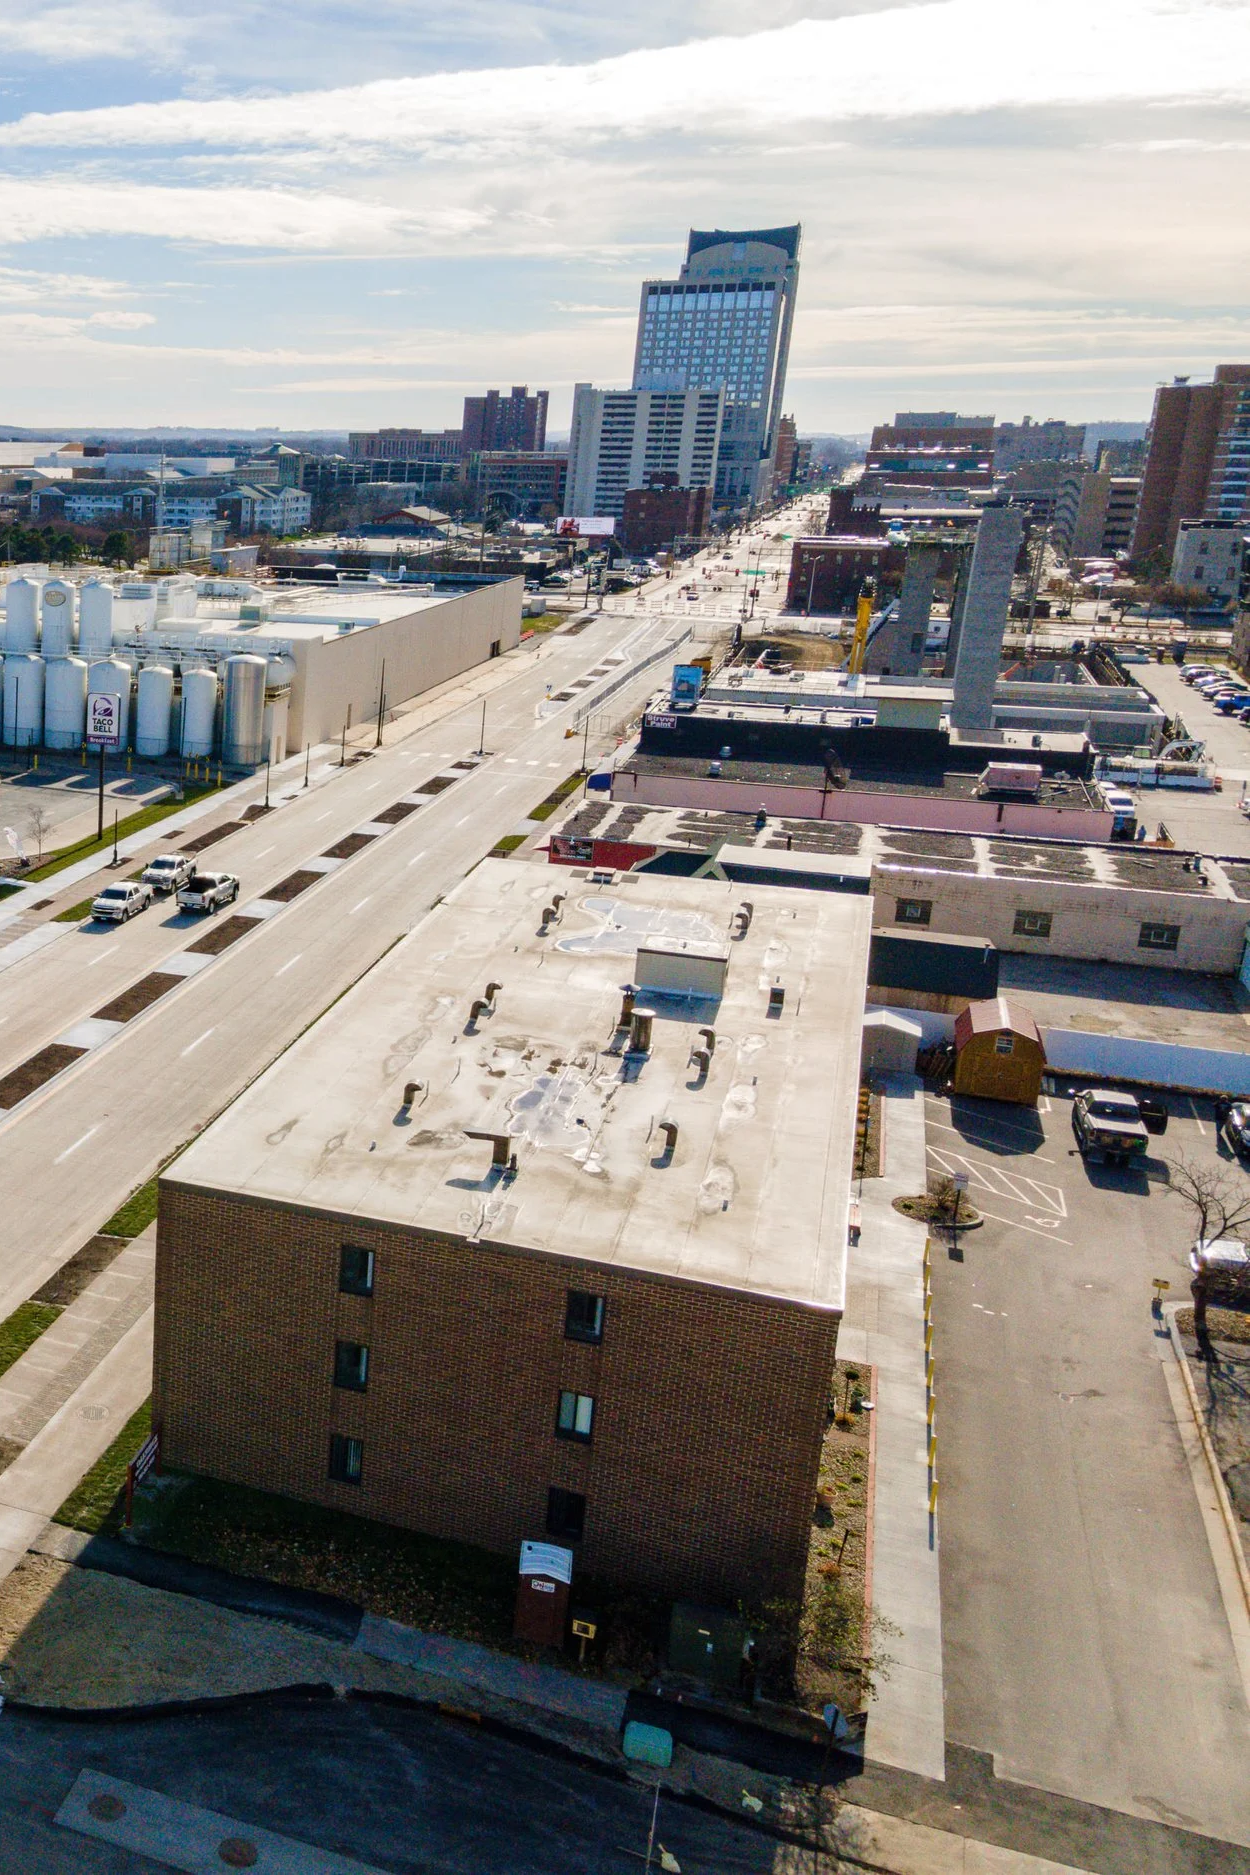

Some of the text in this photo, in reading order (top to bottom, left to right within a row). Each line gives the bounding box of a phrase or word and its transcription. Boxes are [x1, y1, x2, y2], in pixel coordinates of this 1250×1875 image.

[92, 717, 113, 726] TACO
[651, 720, 671, 728] Paint
[94, 725, 113, 733] BELL
